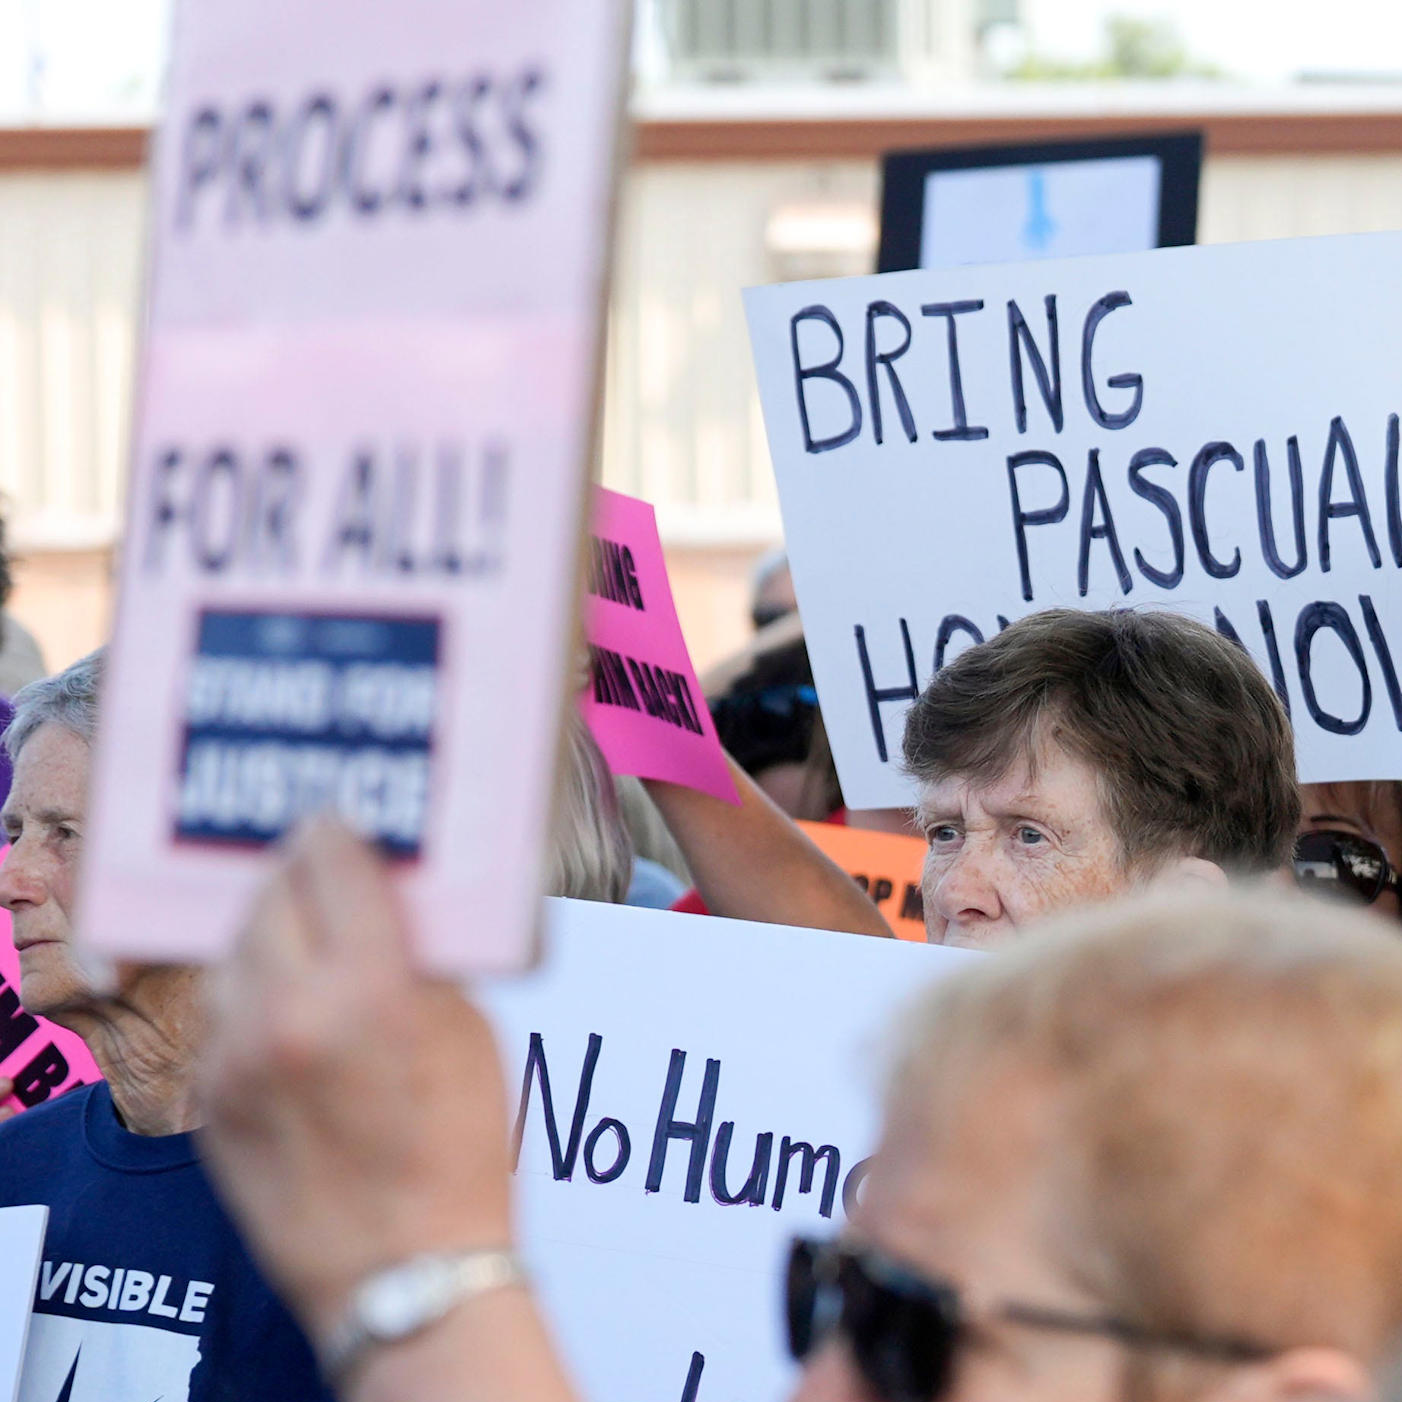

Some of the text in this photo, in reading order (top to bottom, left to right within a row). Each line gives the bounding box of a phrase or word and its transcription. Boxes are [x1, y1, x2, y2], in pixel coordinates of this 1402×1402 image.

[172, 64, 549, 238] PROCESS
[790, 289, 1145, 454] BRING
[144, 440, 510, 578] FOR ALL!
[512, 1032, 632, 1184] No
[40, 1261, 215, 1323] VISIBLE
